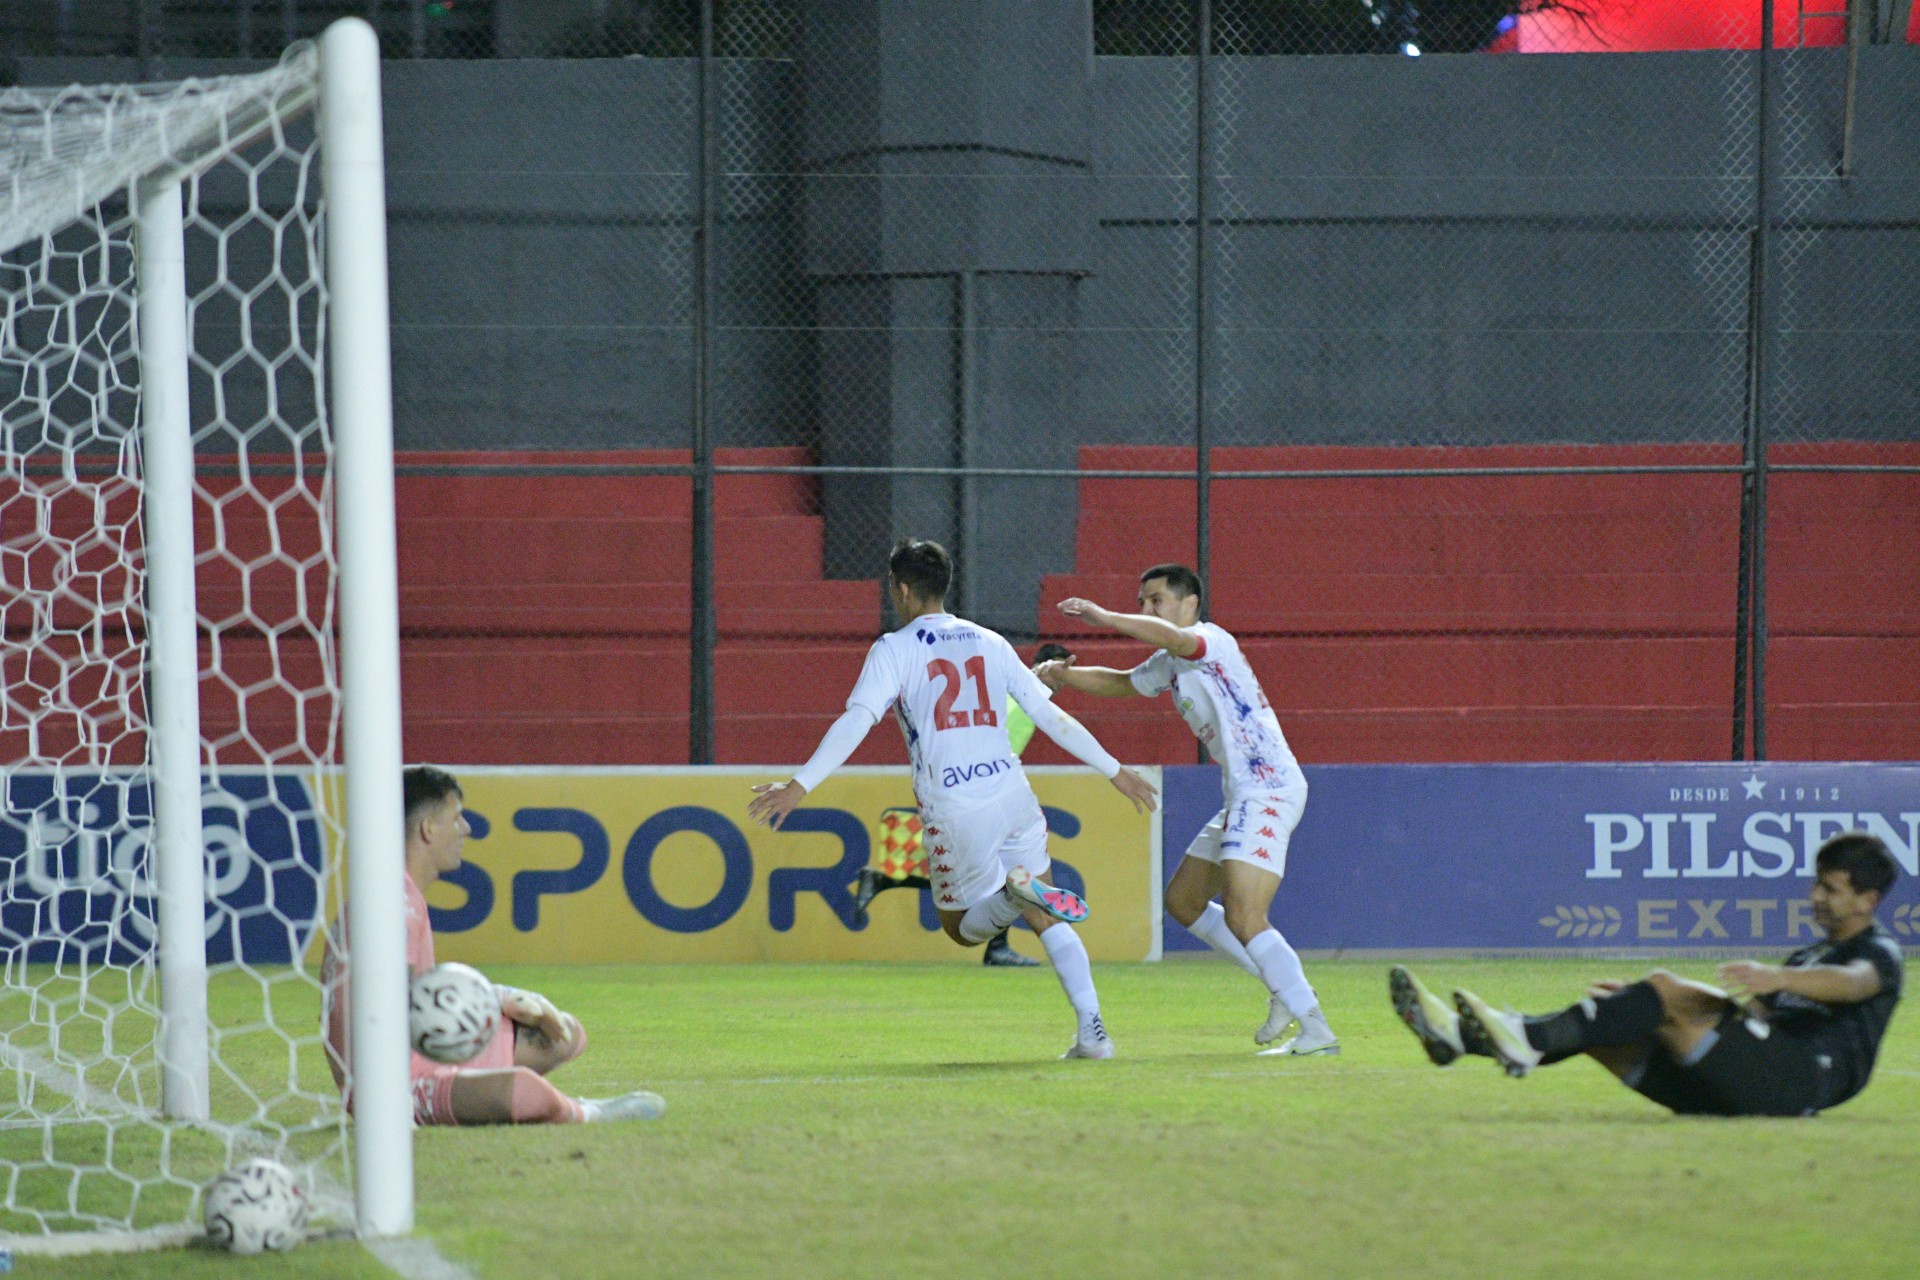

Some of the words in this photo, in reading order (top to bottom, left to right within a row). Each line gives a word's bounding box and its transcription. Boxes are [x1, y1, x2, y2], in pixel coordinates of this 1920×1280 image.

[927, 656, 998, 731] 21
[943, 759, 1011, 788] avon
[1670, 788, 1729, 801] DESDE
[1780, 788, 1839, 801] 1912
[427, 806, 1086, 933] SPORS
[1637, 899, 1828, 939] EXTR
